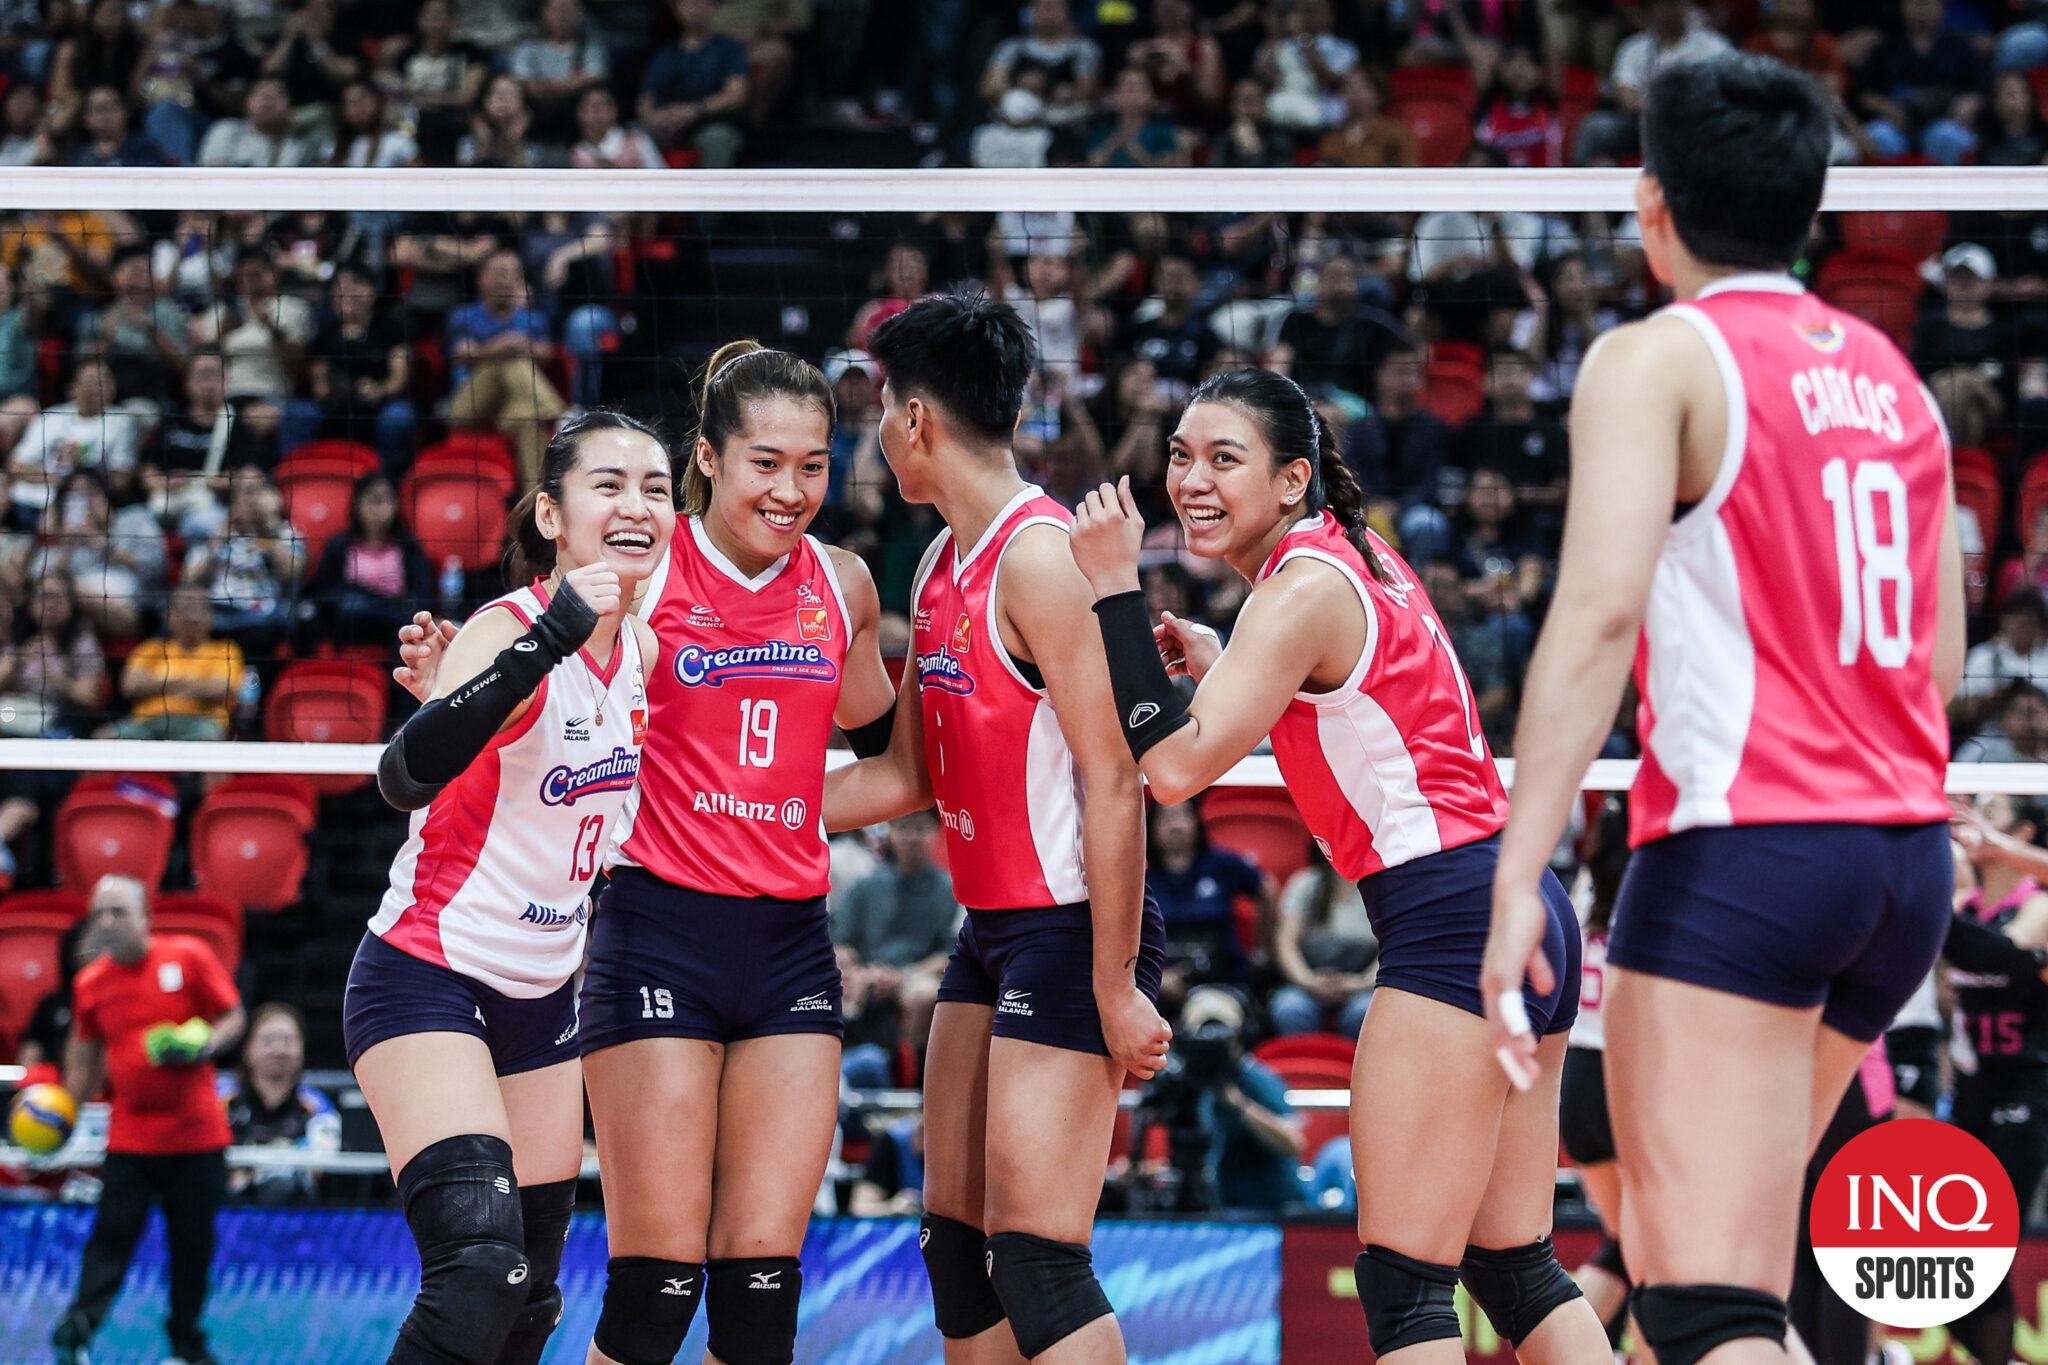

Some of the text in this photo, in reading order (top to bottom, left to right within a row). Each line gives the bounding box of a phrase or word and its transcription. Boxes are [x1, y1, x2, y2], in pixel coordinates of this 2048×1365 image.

[1790, 364, 1904, 443] CARLOS
[1821, 457, 1913, 669] 18
[689, 614, 721, 623] WORLD
[677, 641, 819, 685] Creamline
[565, 728, 589, 736] WORLD
[738, 698, 779, 768] 19
[545, 751, 639, 806] Creamline
[692, 790, 776, 822] Allianz
[569, 814, 604, 881] 13
[518, 900, 576, 926] Allian
[639, 986, 675, 1019] 19
[790, 1004, 832, 1012] BALANCE
[1001, 1000, 1030, 1009] WORLD
[660, 1287, 692, 1296] MIZUNO
[747, 1281, 781, 1290] MIZUNO
